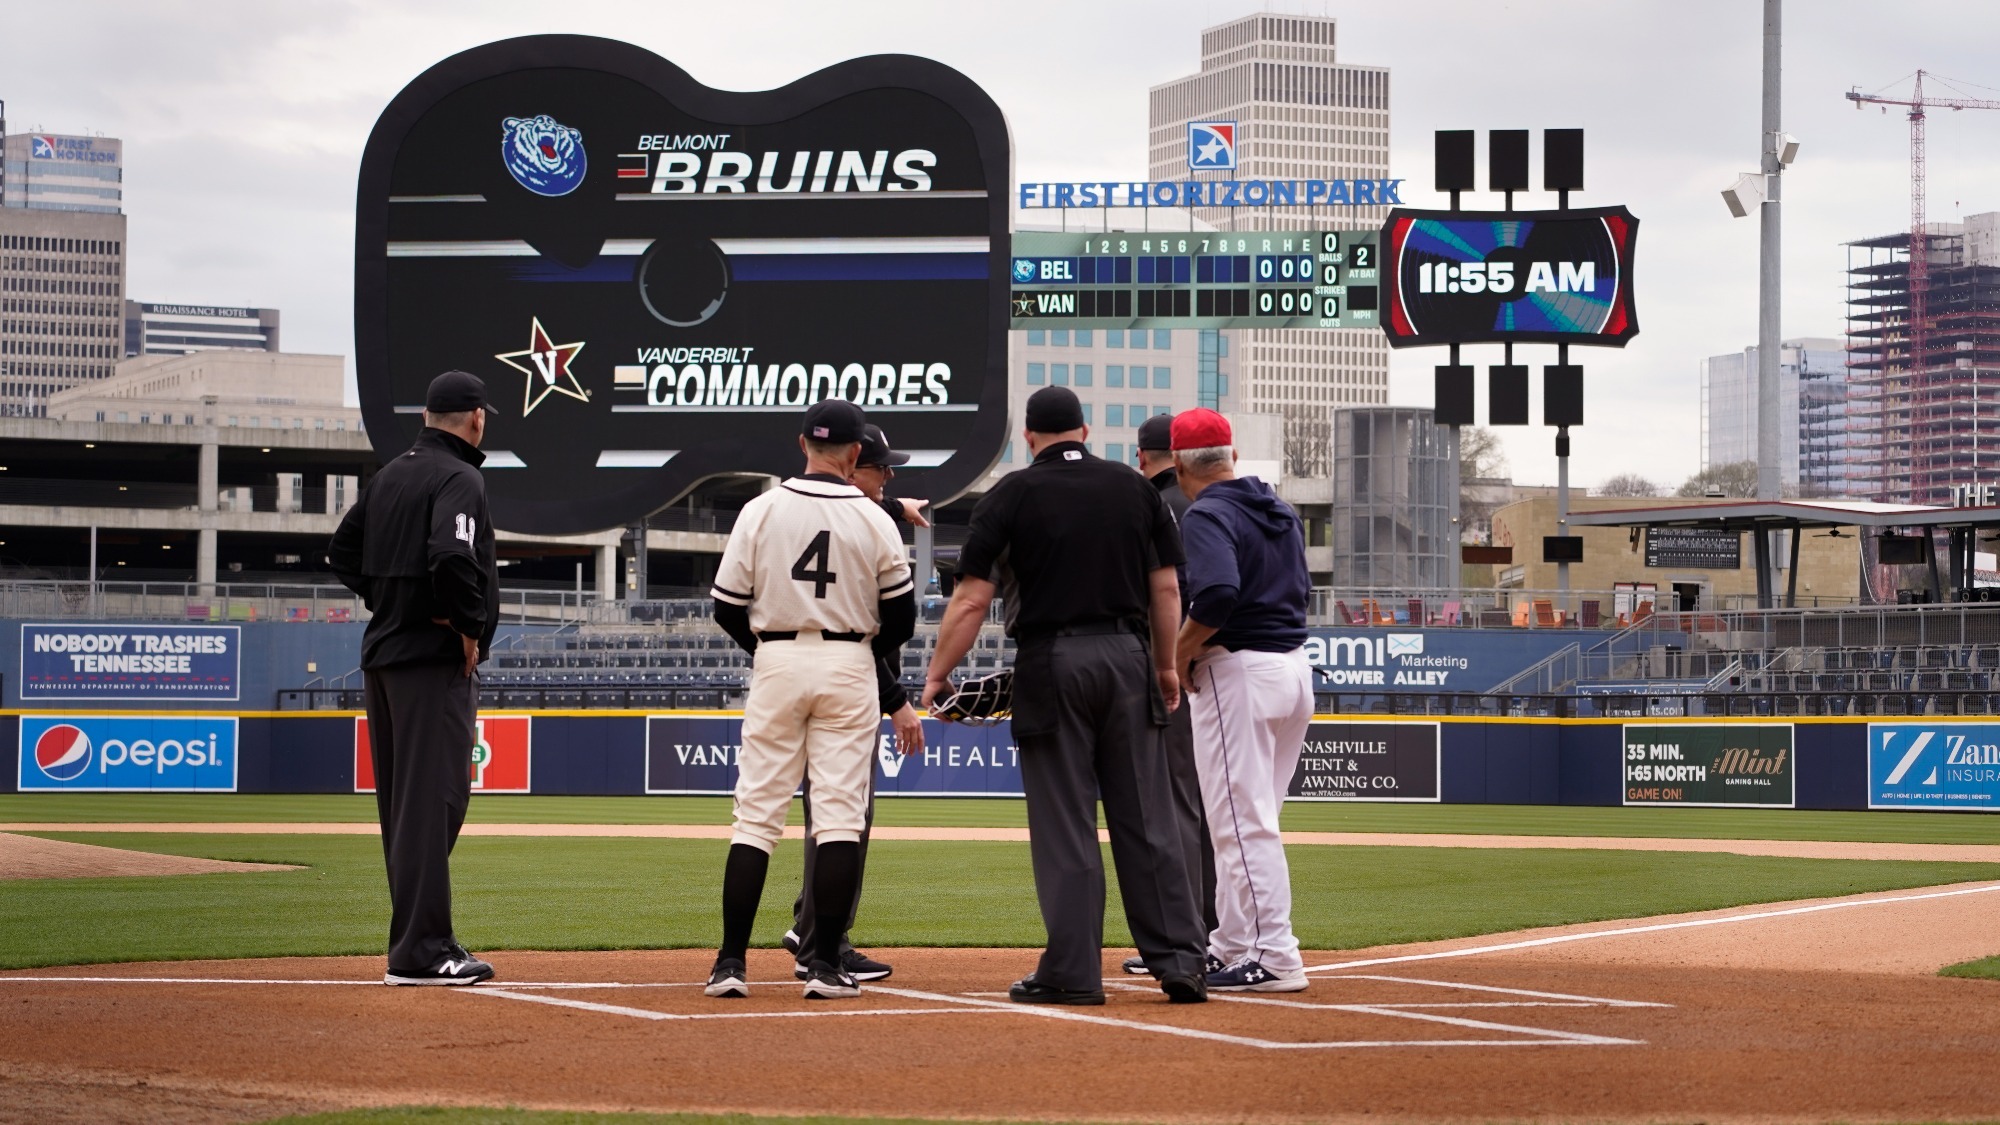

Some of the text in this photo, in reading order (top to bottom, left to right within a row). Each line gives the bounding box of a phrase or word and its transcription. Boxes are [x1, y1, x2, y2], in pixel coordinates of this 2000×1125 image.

[56, 138, 93, 149] FIRST
[637, 134, 730, 151] BELMONT
[56, 150, 116, 162] HORIZON
[651, 149, 937, 194] BRUINS
[1021, 178, 1402, 209] FIRST HORIZON PARK
[1085, 239, 1310, 253] 1 2 3 4 5 6 7 8 9 R H E
[1324, 233, 1336, 252] 0
[1318, 253, 1342, 262] BALLS
[1356, 247, 1368, 266] 2
[1040, 259, 1312, 279] BEL 0 0 0
[1324, 266, 1336, 285] 0
[1349, 269, 1376, 278] AT BAT
[1419, 261, 1595, 294] 11:55 AM
[1314, 286, 1346, 295] STRIKES
[153, 305, 249, 317] RENAISSANCE HOTEL
[1037, 293, 1312, 313] VAN 0 0 0
[1324, 298, 1336, 317] 0
[1320, 319, 1341, 327] OUTS
[1353, 311, 1371, 319] MPH
[637, 347, 753, 364] VANDERBILT
[648, 362, 951, 406] COMMODORES
[1949, 482, 1996, 508] THE
[791, 530, 836, 599] 4
[34, 634, 227, 654] NOBODY TRASHES
[71, 655, 191, 673] TENNESSEE
[1401, 655, 1468, 670] Marketing
[1322, 670, 1449, 685] POWER ALLEY
[101, 733, 216, 774] pepsi
[1301, 741, 1387, 754] NASHVILLE
[1627, 744, 1684, 760] 35 MIN.
[1946, 735, 2000, 765] Zan
[1301, 758, 1358, 771] TENT &
[1719, 748, 1787, 775] Mint
[1627, 765, 1706, 781] I-65 NORTH
[1301, 776, 1399, 789] AWNING CO.
[1628, 788, 1682, 800] GAME ON!
